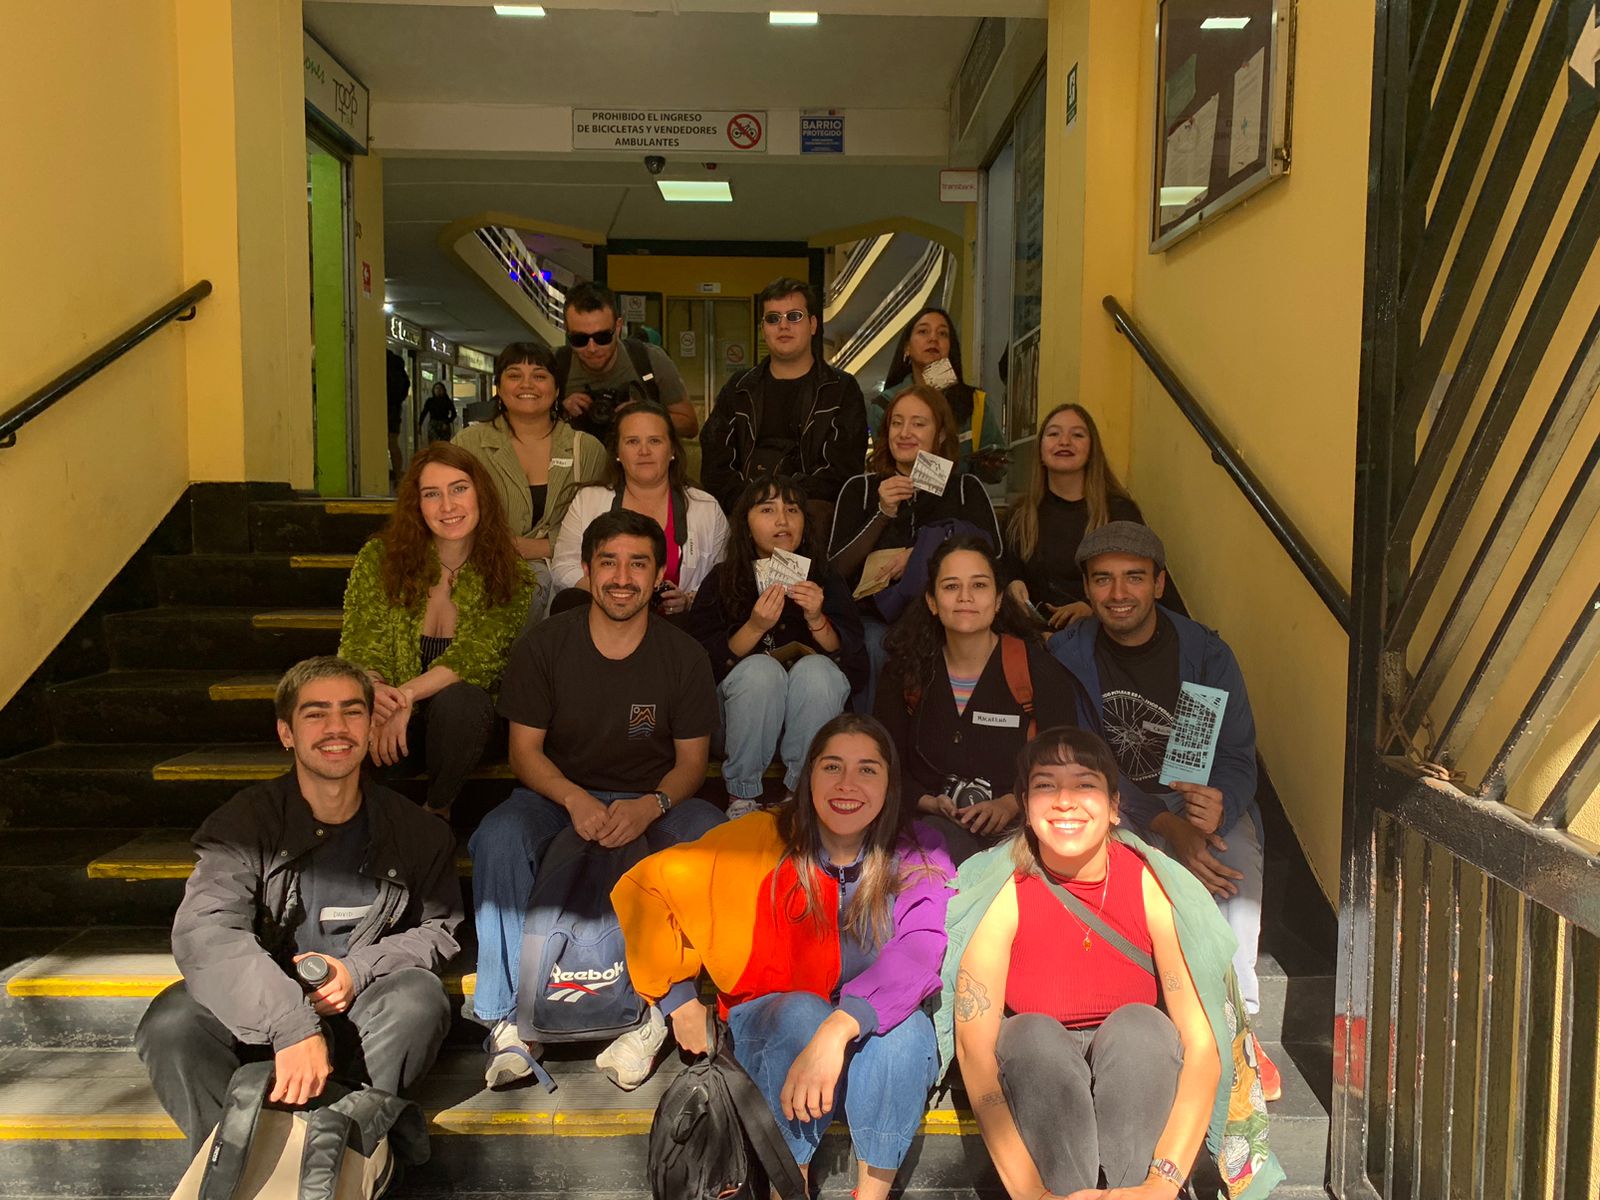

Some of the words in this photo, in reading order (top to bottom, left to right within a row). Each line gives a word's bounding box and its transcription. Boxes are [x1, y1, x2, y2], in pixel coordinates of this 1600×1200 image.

[592, 112, 646, 121] PROHIBIDO
[648, 113, 658, 122] EL
[660, 113, 702, 122] INGRESO
[577, 124, 590, 133] DE
[592, 125, 644, 134] BICICLETAS
[645, 126, 652, 134] Y
[654, 126, 717, 135] VENDEDORES
[802, 120, 842, 130] BARRIO
[615, 138, 680, 147] AMBULANTES
[550, 960, 624, 983] Reebok
